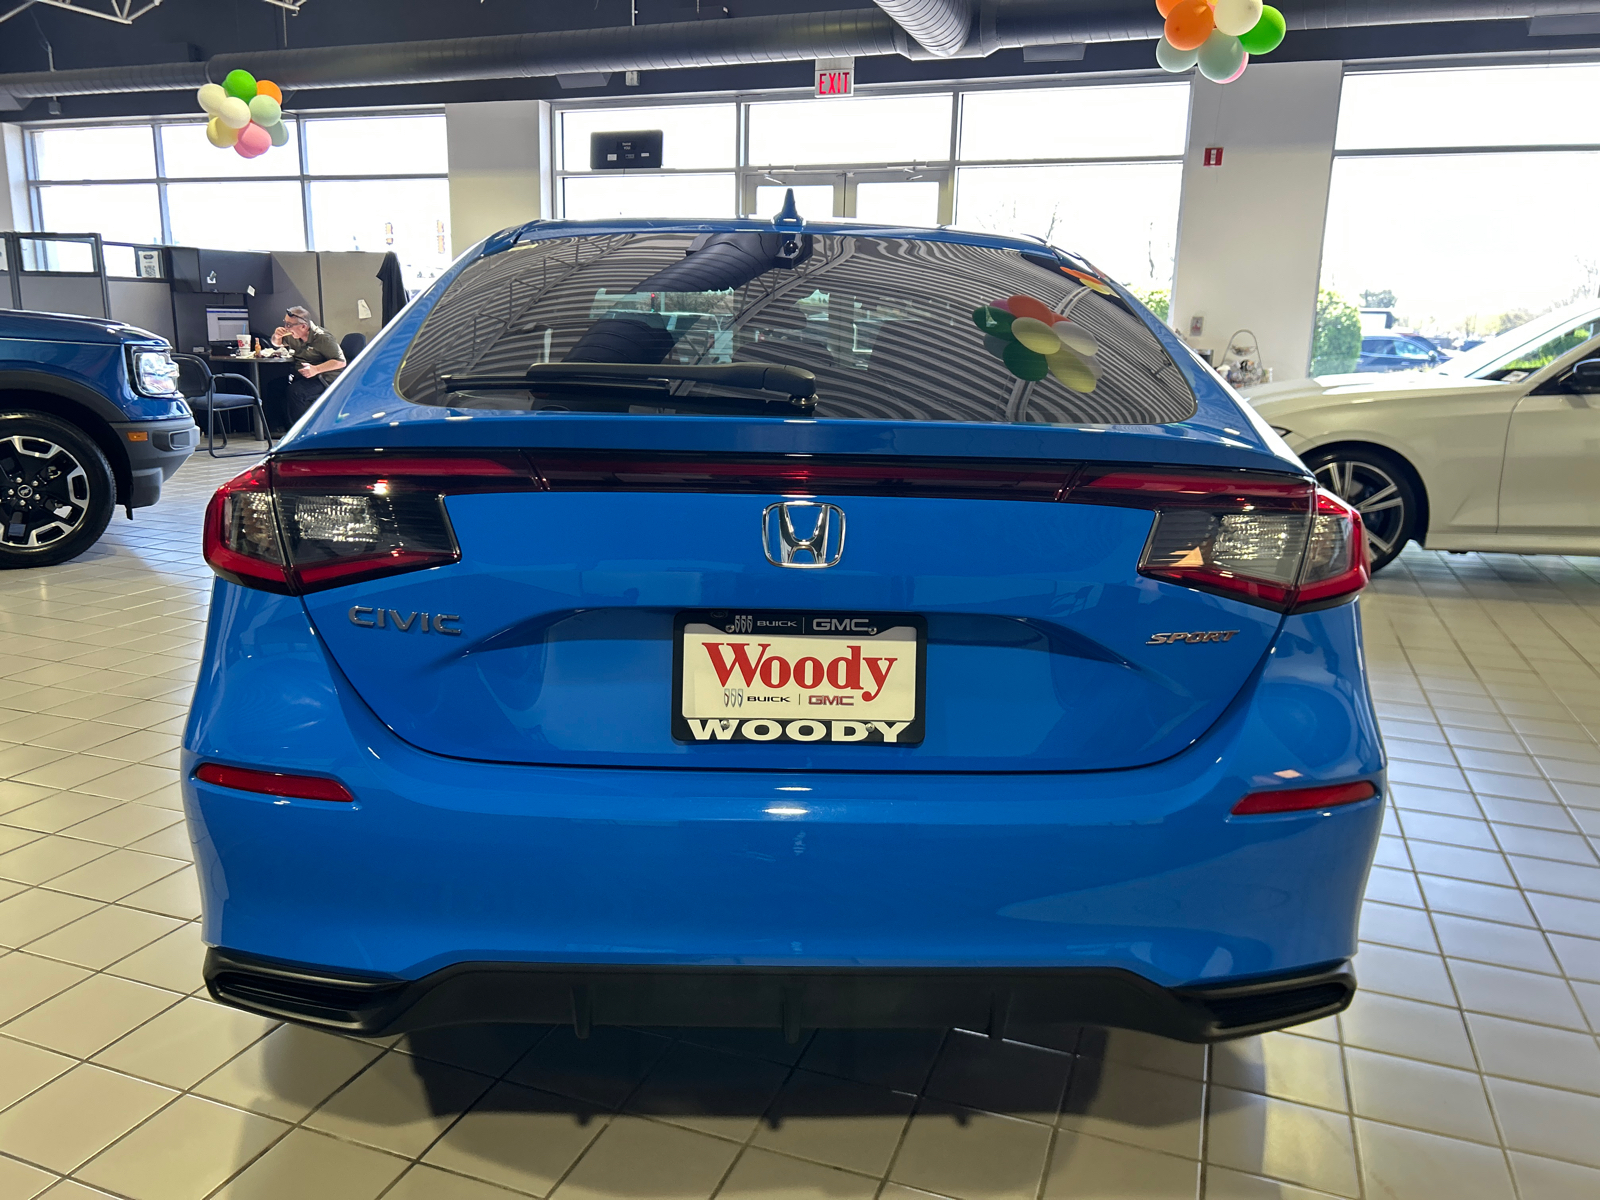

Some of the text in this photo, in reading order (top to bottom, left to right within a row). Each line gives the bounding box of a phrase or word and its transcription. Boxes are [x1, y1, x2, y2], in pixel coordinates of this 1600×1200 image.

[819, 72, 850, 95] EXIT
[348, 605, 461, 633] CIVIC
[812, 618, 870, 631] GMC
[1145, 630, 1241, 645] SPORT
[701, 642, 898, 702] Woody
[747, 695, 855, 706] BUICK GMC
[687, 718, 911, 743] WOODY
